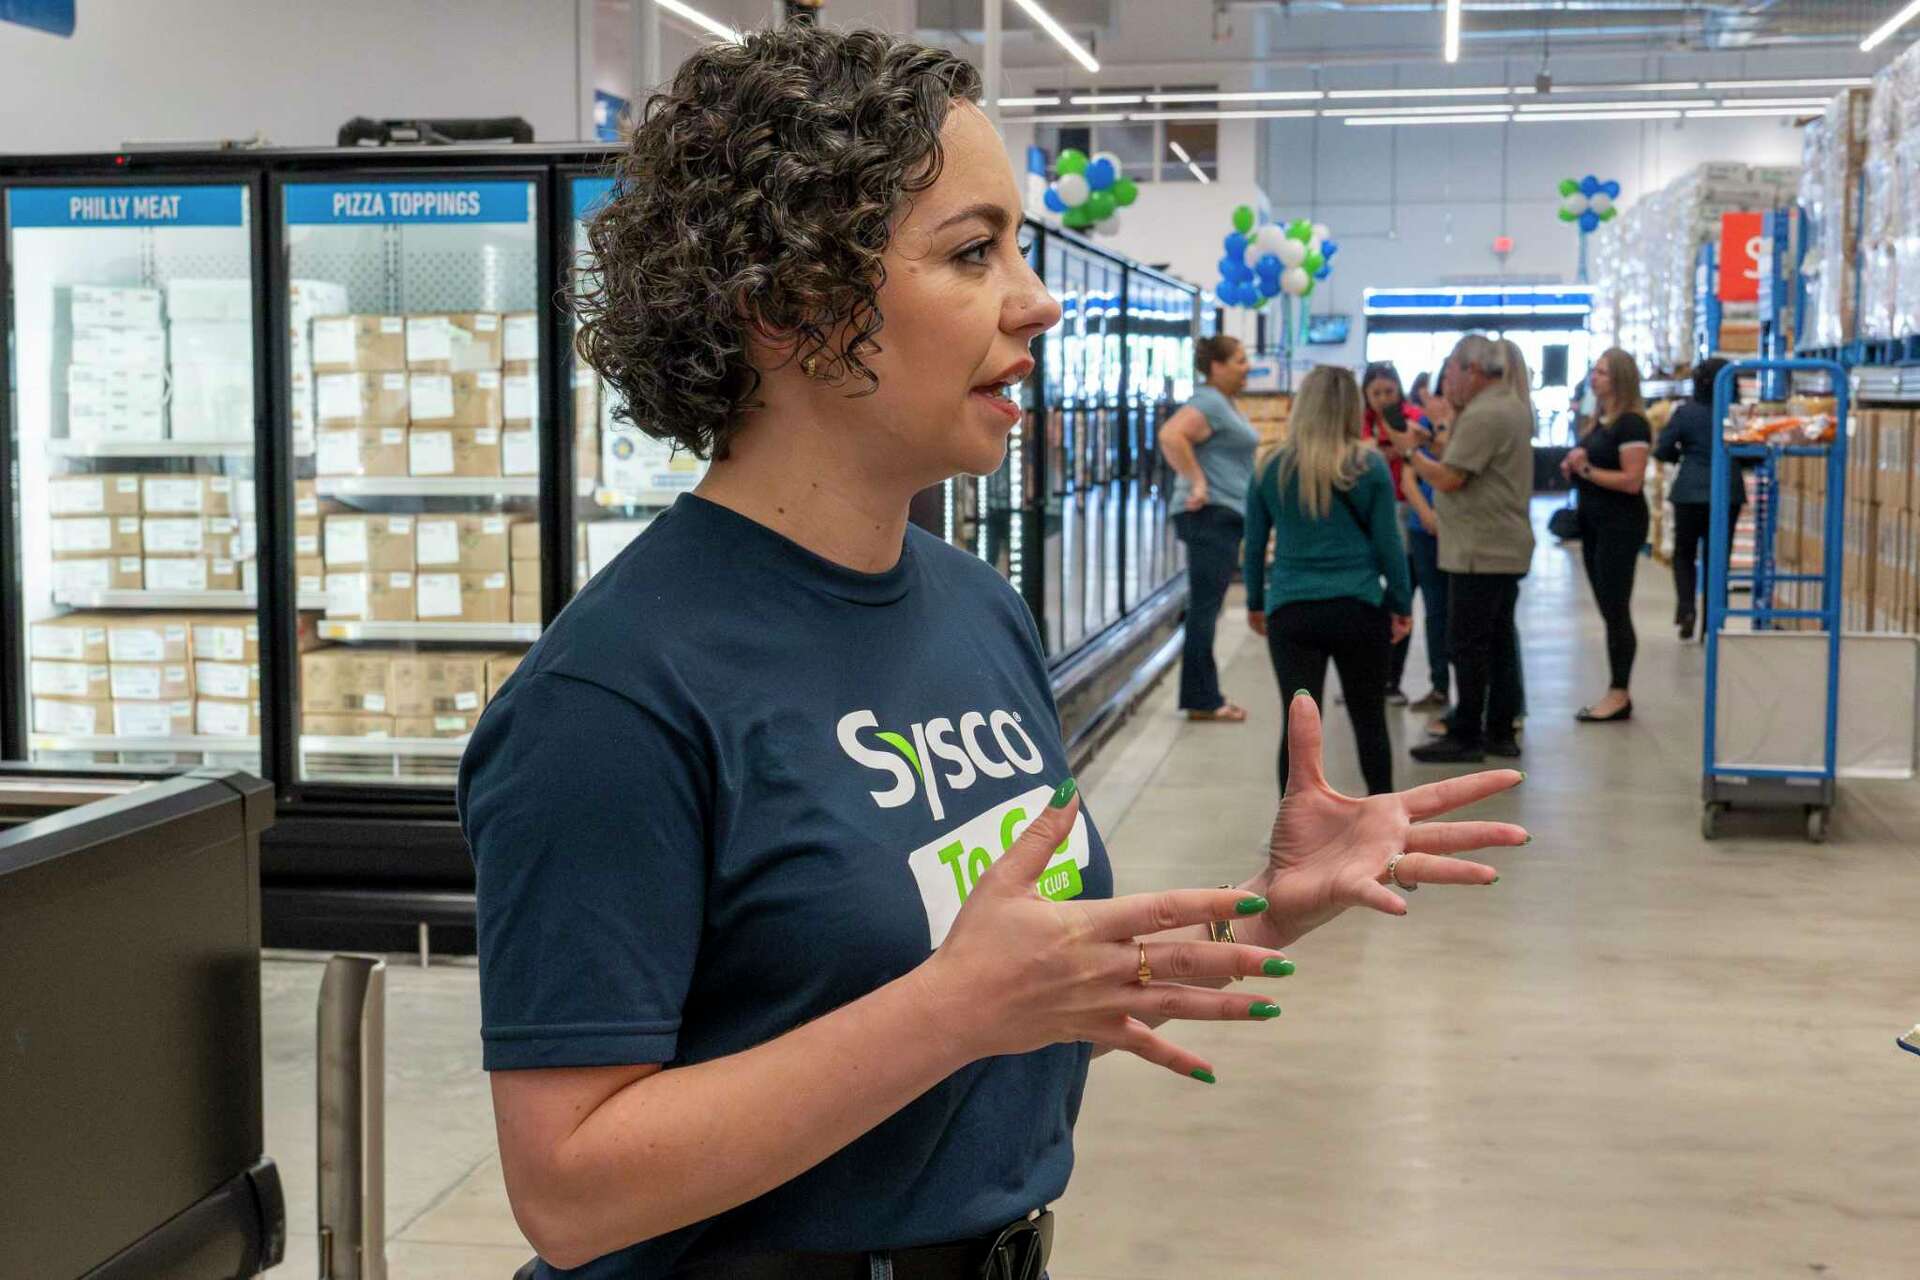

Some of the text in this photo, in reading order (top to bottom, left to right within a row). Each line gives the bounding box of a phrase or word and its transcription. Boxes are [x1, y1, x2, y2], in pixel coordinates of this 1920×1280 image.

[70, 195, 181, 220] PHILLY MEAT
[333, 191, 480, 216] PIZZA TOPPINGS
[1044, 871, 1069, 895] CLUB
